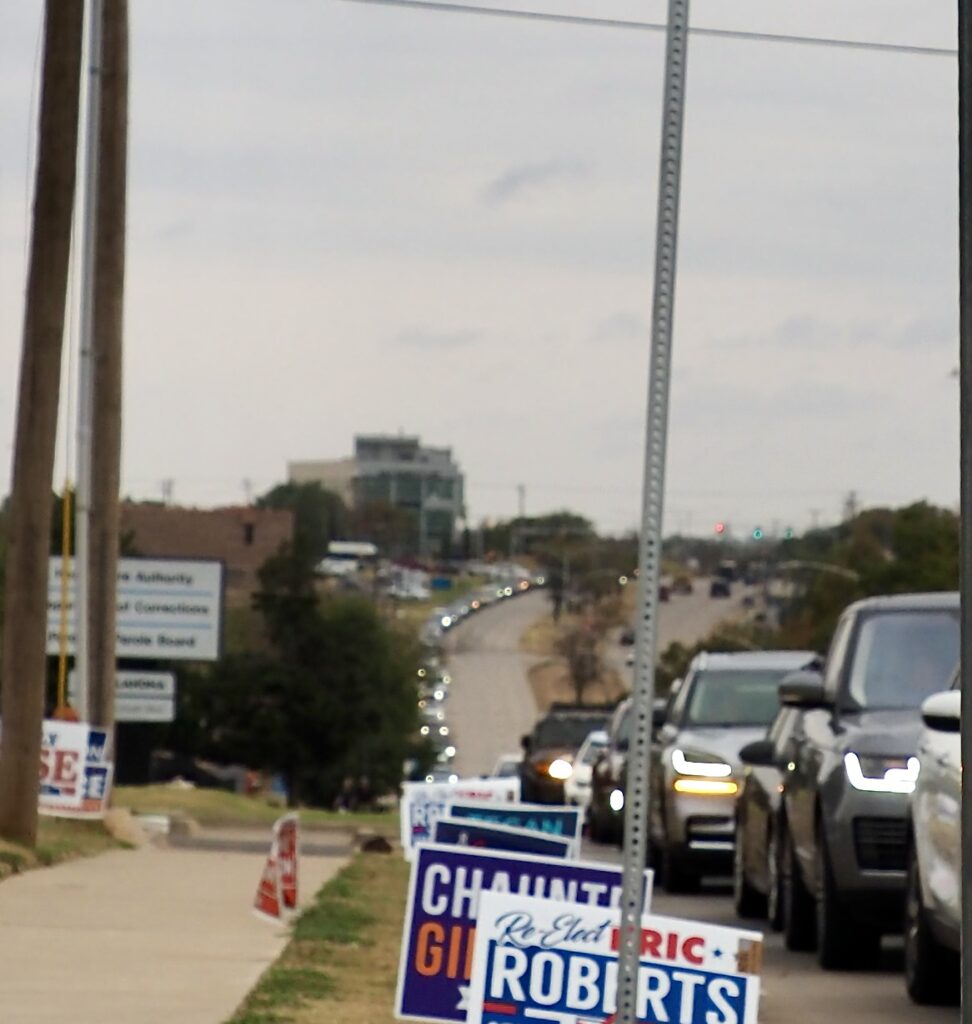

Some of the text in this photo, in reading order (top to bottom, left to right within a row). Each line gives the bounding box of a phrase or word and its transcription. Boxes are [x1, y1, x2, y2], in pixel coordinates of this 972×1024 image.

[136, 572, 194, 586] Authority
[134, 602, 209, 616] Corrections
[117, 634, 196, 648] arole Board
[494, 910, 613, 950] Re-Elect
